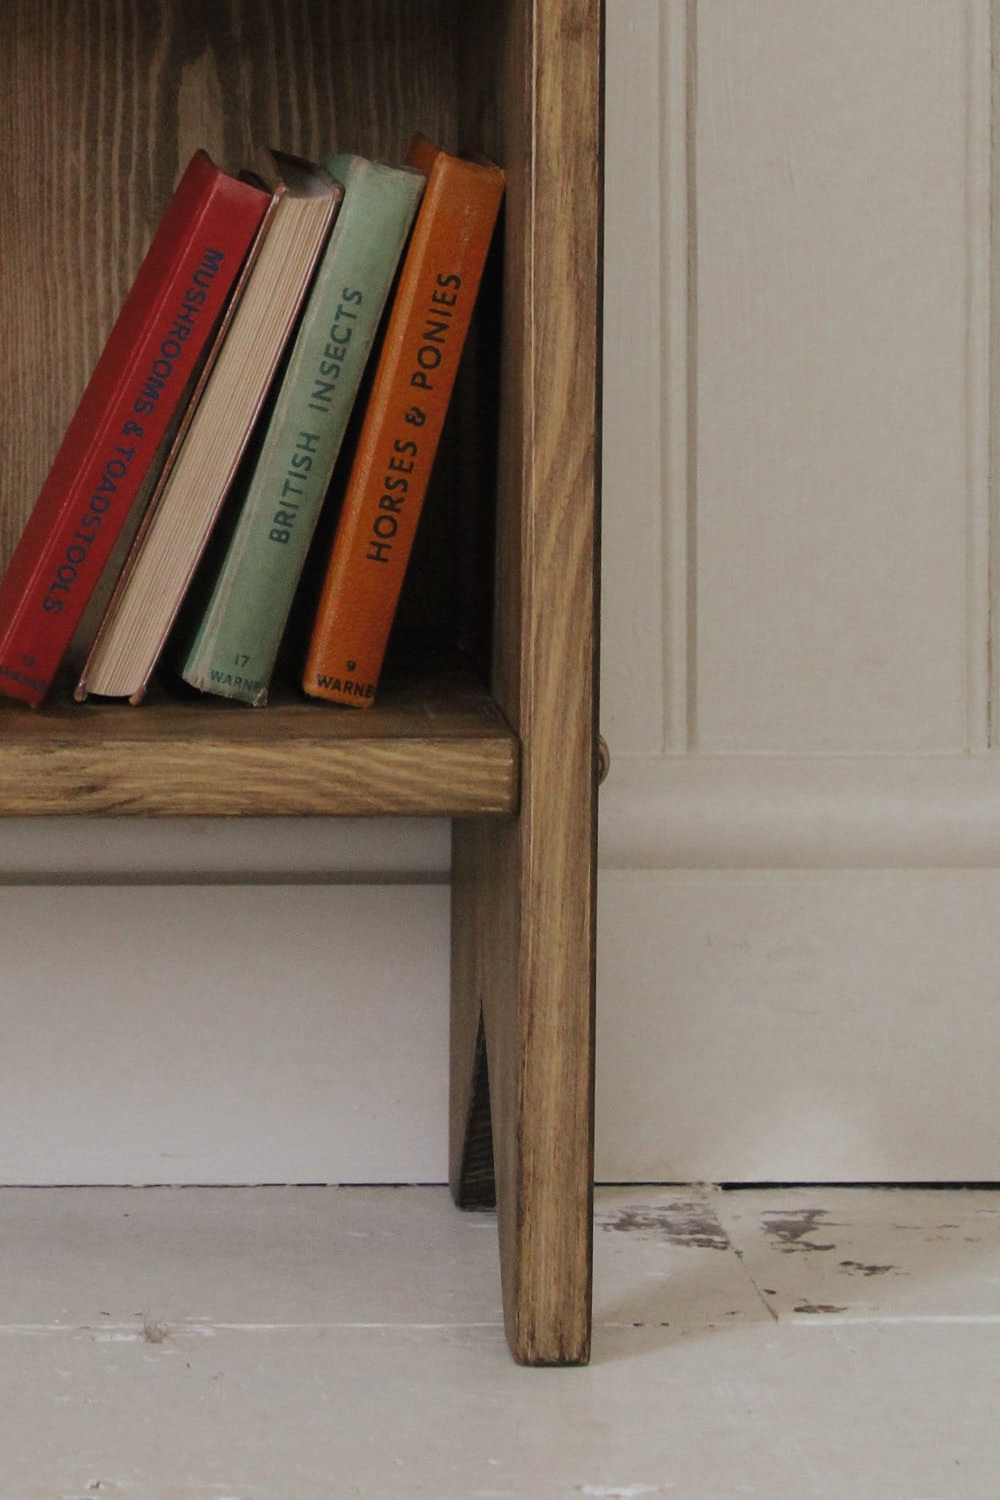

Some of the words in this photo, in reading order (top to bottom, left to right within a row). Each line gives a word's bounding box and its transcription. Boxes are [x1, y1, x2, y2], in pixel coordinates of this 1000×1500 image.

[133, 247, 225, 416] MUSHROOMS
[410, 273, 462, 391] PONIES
[121, 420, 145, 437] &
[268, 431, 320, 545] BRITISH
[308, 286, 363, 413] INSECTS
[404, 406, 427, 428] &
[42, 446, 137, 613] TOADSTOOLS
[366, 438, 418, 563] HORSES
[234, 653, 251, 668] 17
[316, 673, 375, 699] WARNE
